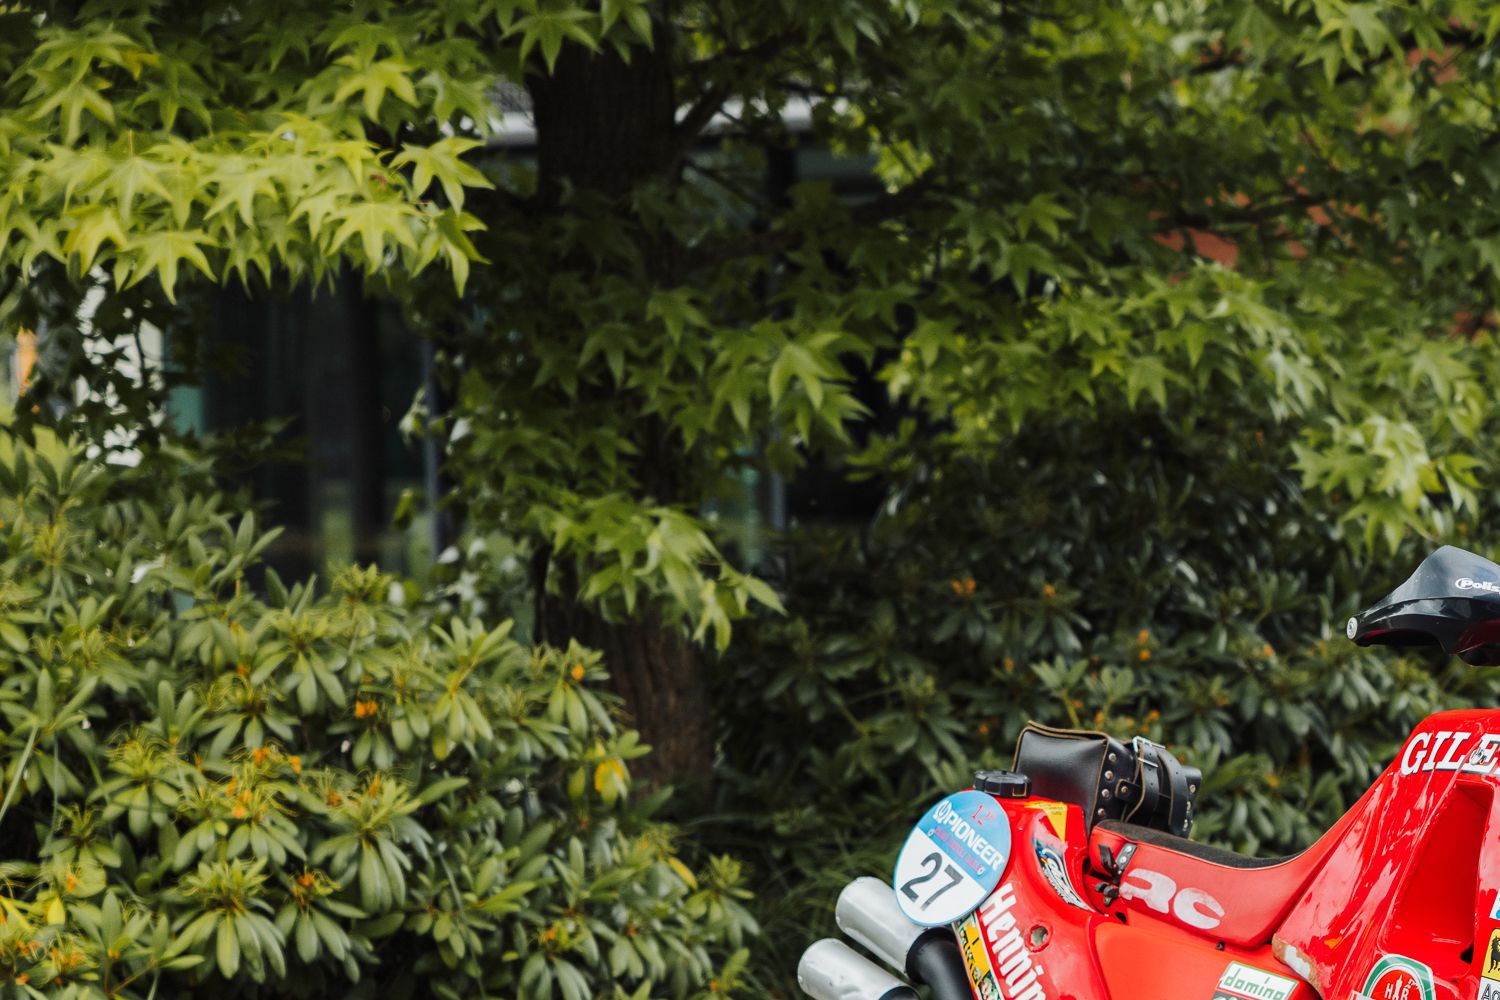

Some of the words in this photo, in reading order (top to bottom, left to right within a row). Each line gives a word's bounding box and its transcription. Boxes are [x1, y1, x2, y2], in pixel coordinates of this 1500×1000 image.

[942, 810, 1004, 871] PIONEER
[900, 852, 964, 911] 27
[1224, 968, 1286, 1000] domino
